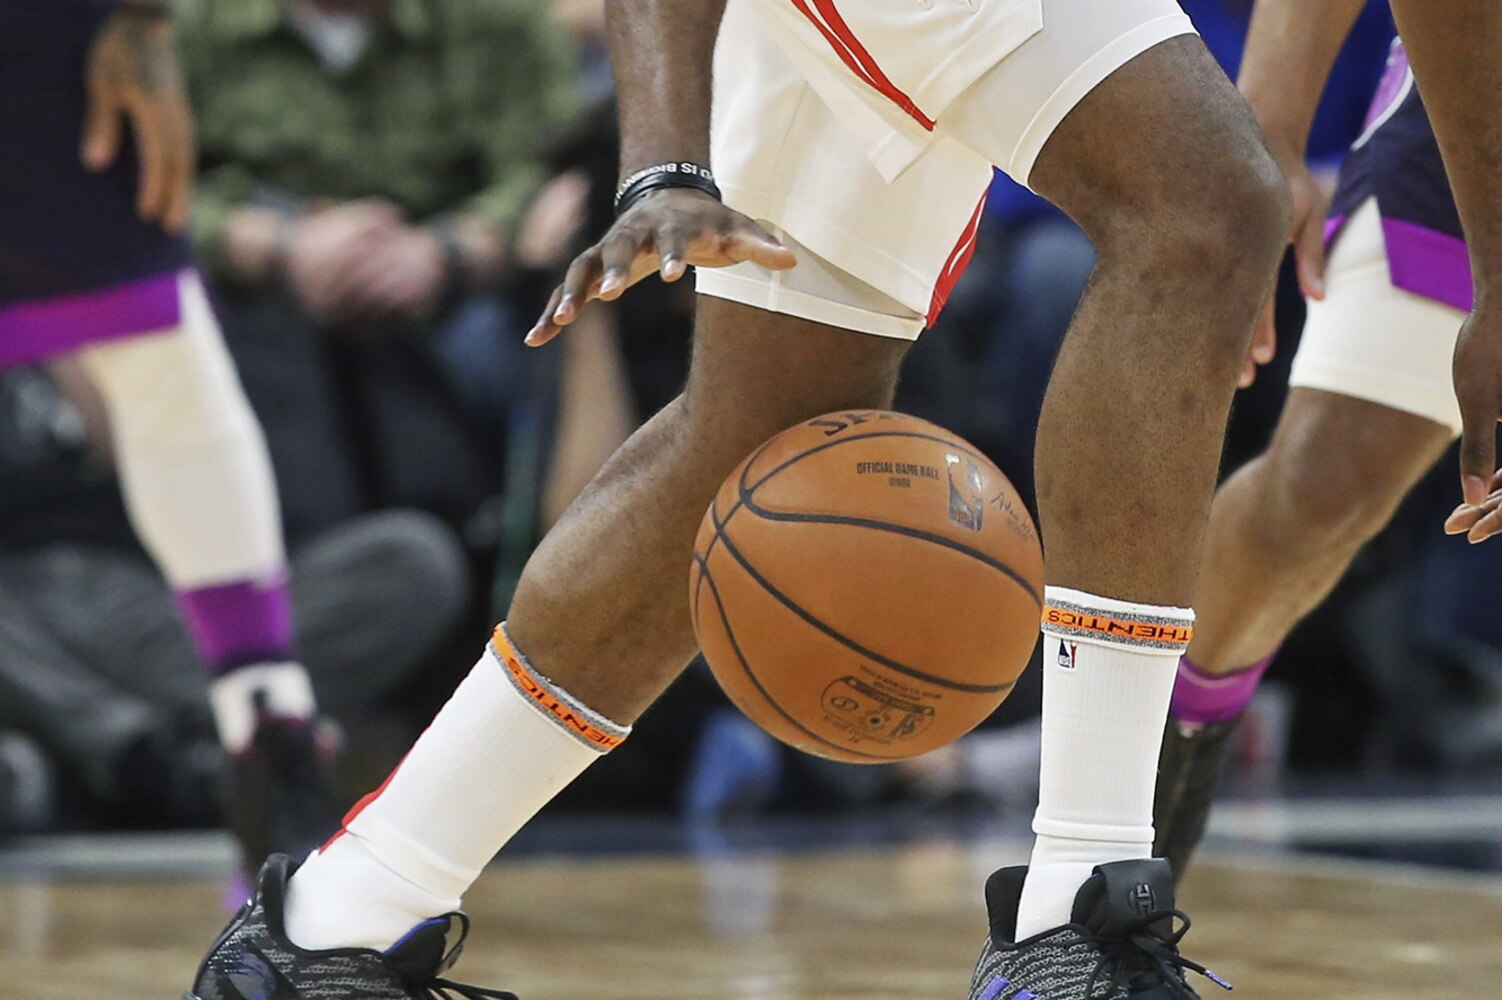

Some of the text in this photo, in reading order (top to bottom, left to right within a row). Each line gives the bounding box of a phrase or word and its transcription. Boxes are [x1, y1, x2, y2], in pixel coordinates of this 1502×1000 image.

[856, 461, 940, 481] OFFICIAL GAME BALL
